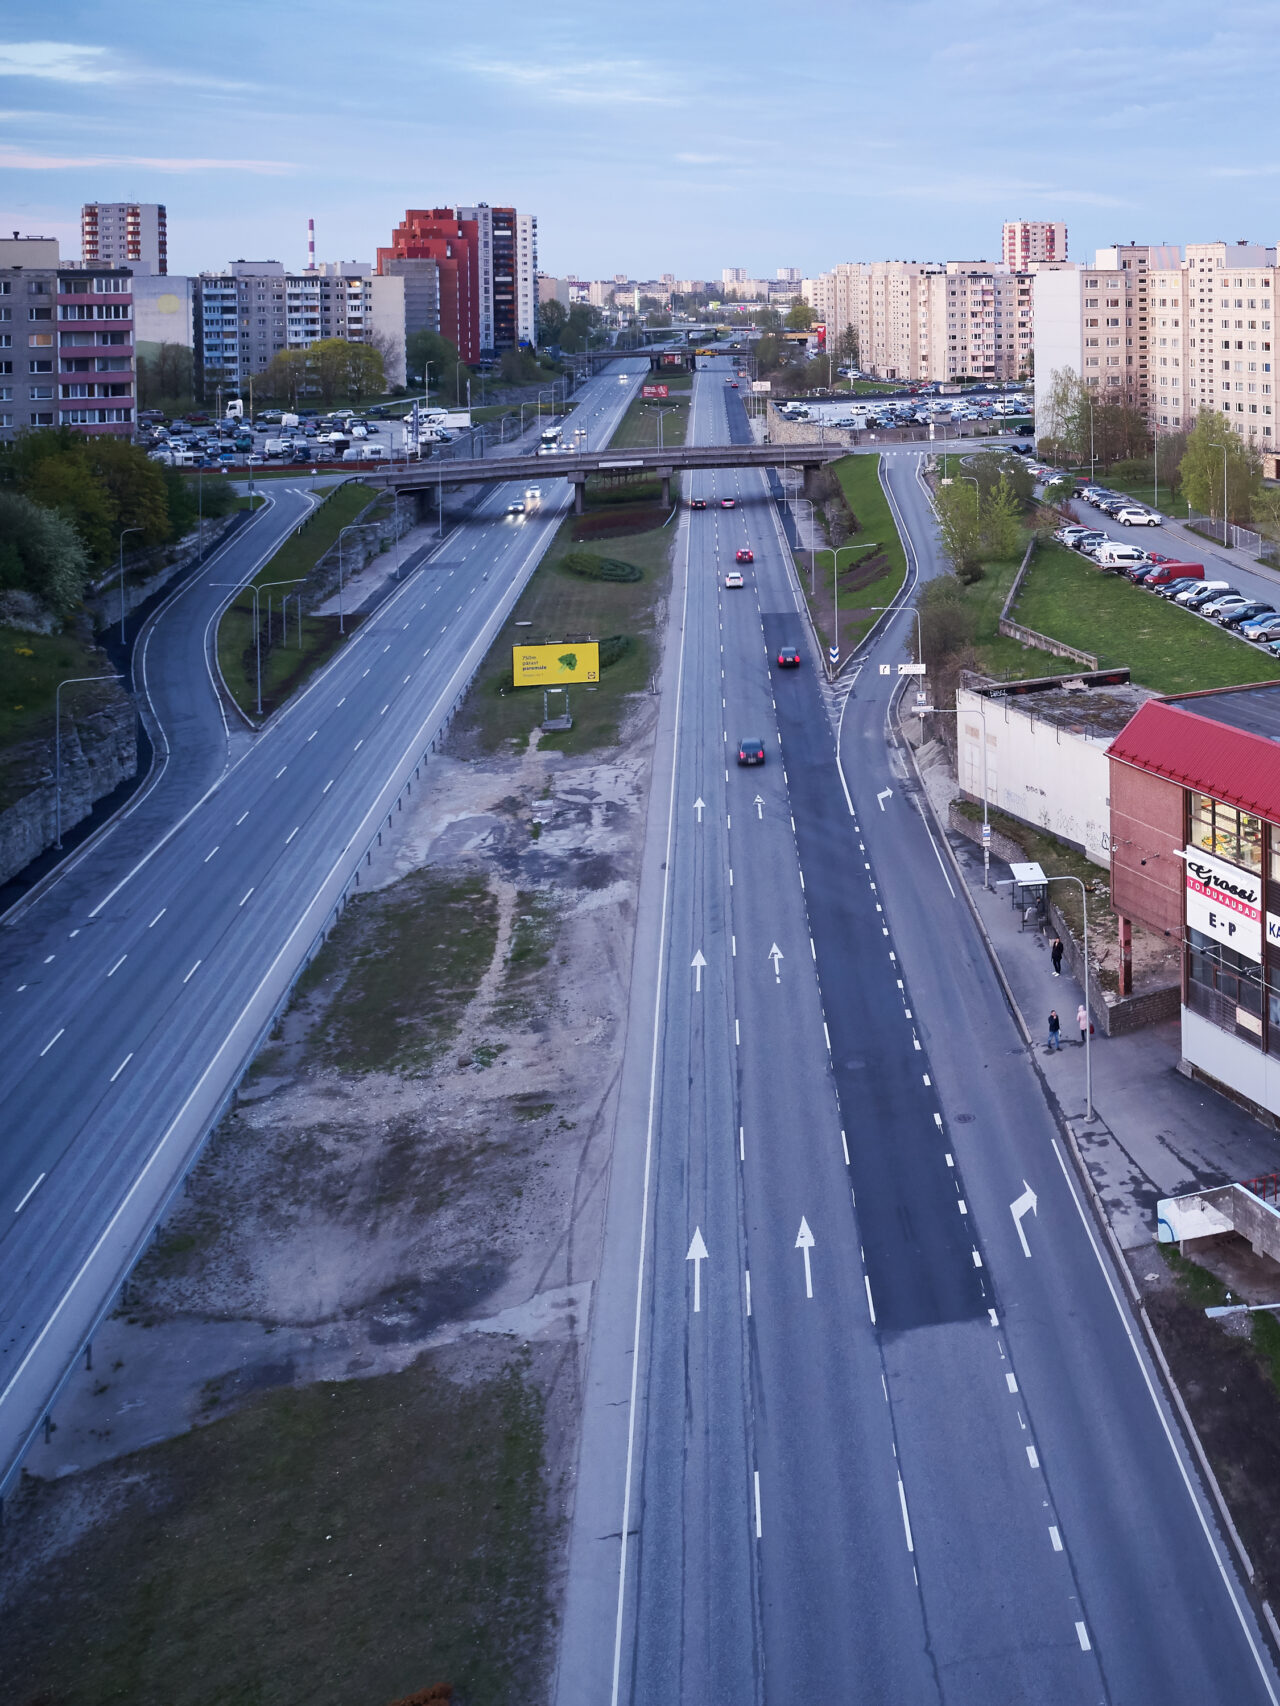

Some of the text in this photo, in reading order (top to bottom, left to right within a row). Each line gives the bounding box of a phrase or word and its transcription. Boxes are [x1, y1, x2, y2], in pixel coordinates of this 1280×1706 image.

[1187, 861, 1258, 904] Grossi
[1189, 879, 1258, 919] TOIDUKAUBAD
[1208, 912, 1217, 929] E
[1228, 922, 1237, 937] P
